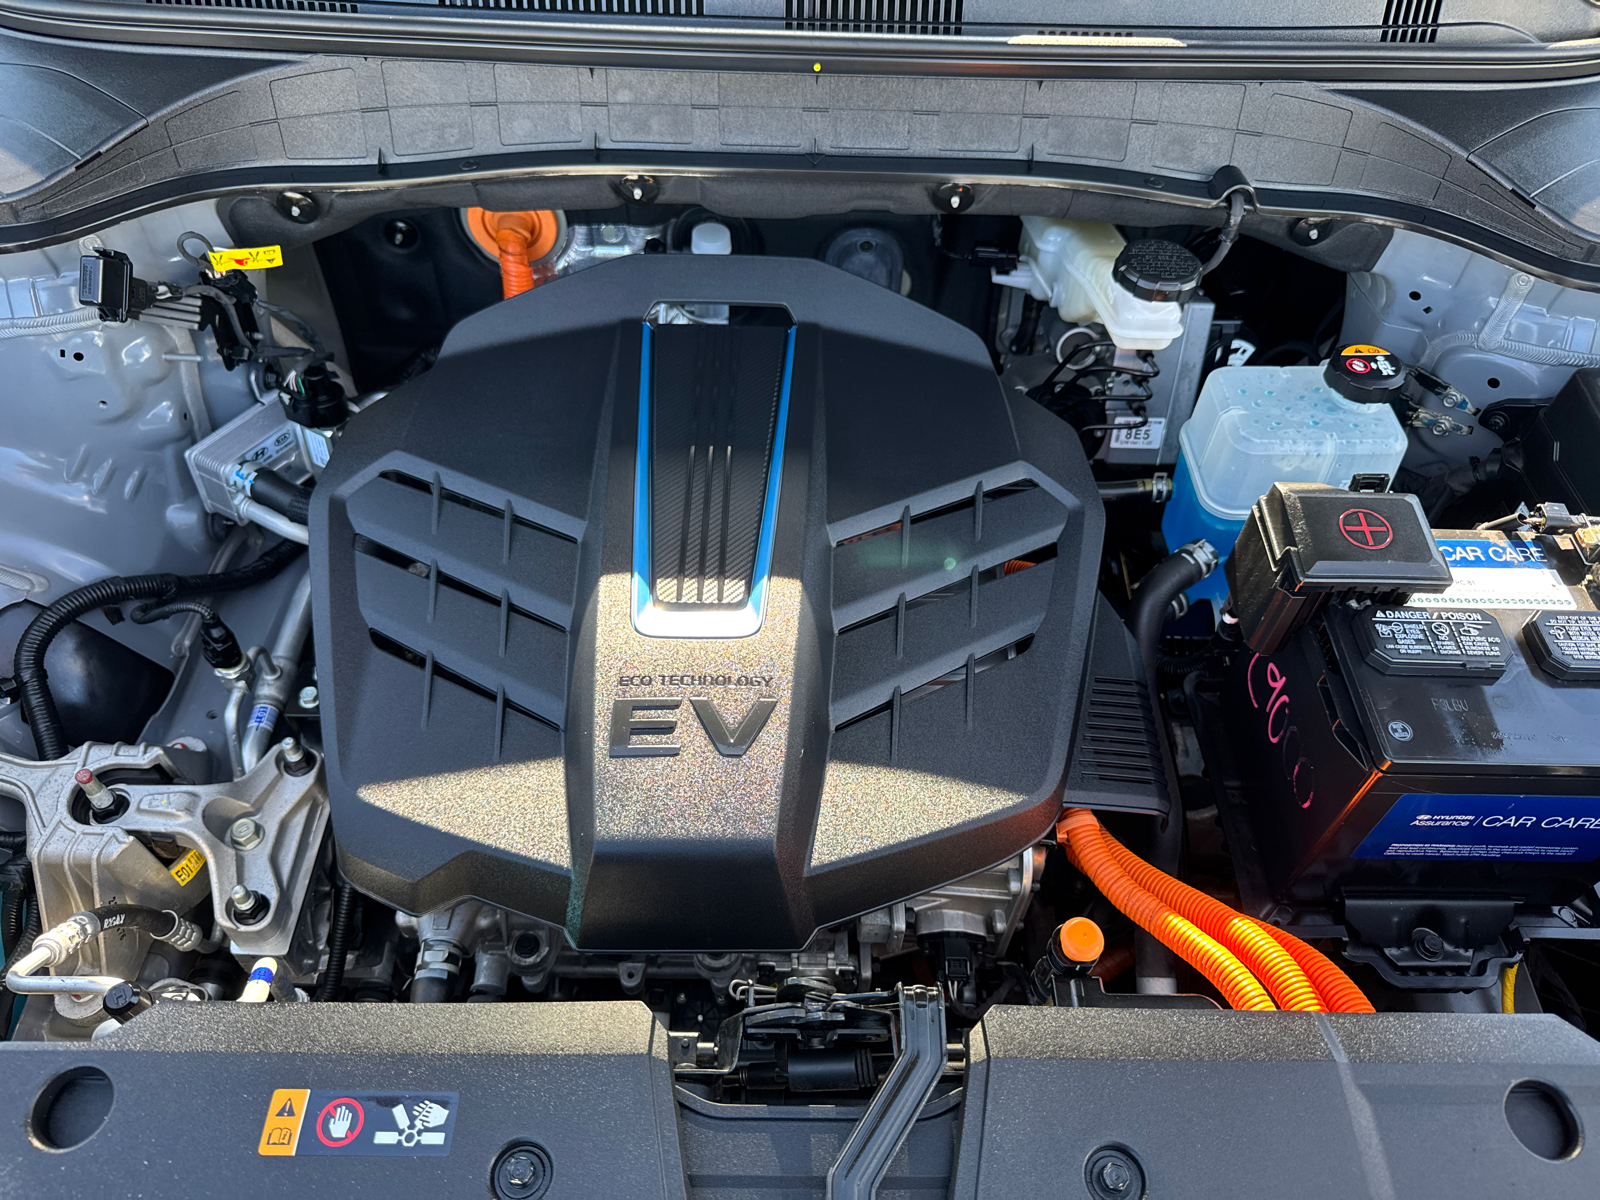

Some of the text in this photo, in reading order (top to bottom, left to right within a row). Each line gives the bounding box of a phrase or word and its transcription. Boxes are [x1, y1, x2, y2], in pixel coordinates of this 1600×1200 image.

[1125, 429, 1150, 440] 8E5
[1438, 546, 1548, 562] CAR CARE
[1386, 610, 1431, 619] DANGER
[1440, 612, 1482, 620] POISON
[619, 675, 774, 688] ECO TECHNOLOGY
[609, 696, 778, 758] EV
[1482, 816, 1537, 827] CAR
